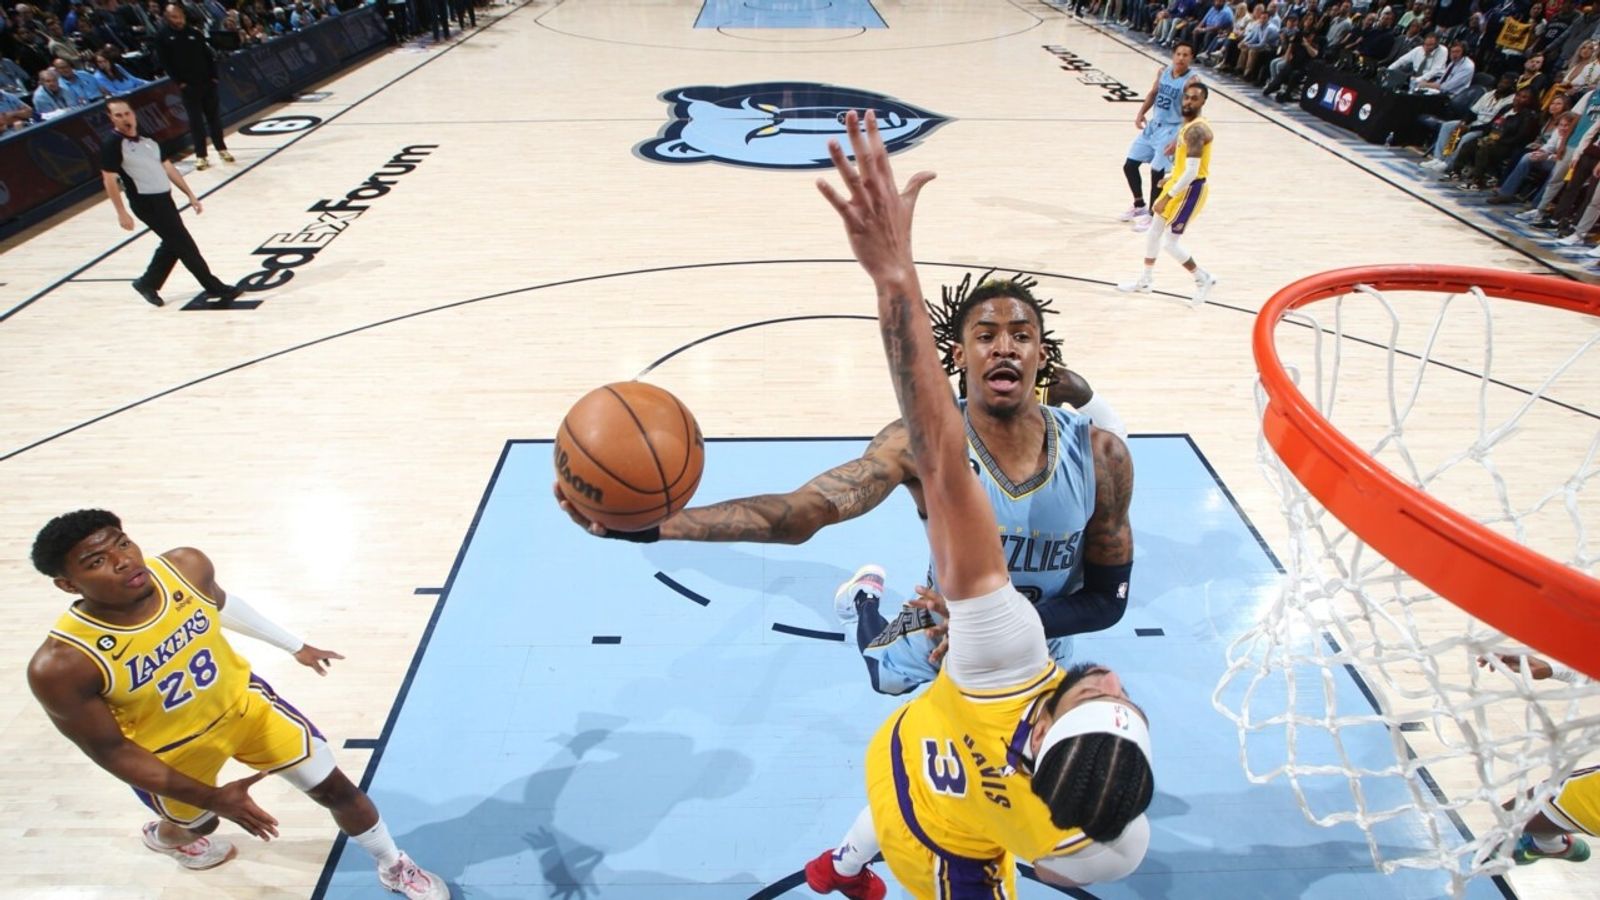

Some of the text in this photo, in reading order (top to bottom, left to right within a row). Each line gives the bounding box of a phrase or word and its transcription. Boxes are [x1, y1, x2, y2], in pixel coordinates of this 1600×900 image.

[1157, 95, 1172, 111] 22
[179, 144, 440, 311] FedExForum
[1000, 530, 1082, 572] ZLIES
[99, 637, 115, 649] 6
[125, 608, 210, 692] LAKERS
[156, 648, 218, 712] 28
[923, 738, 967, 797] 3
